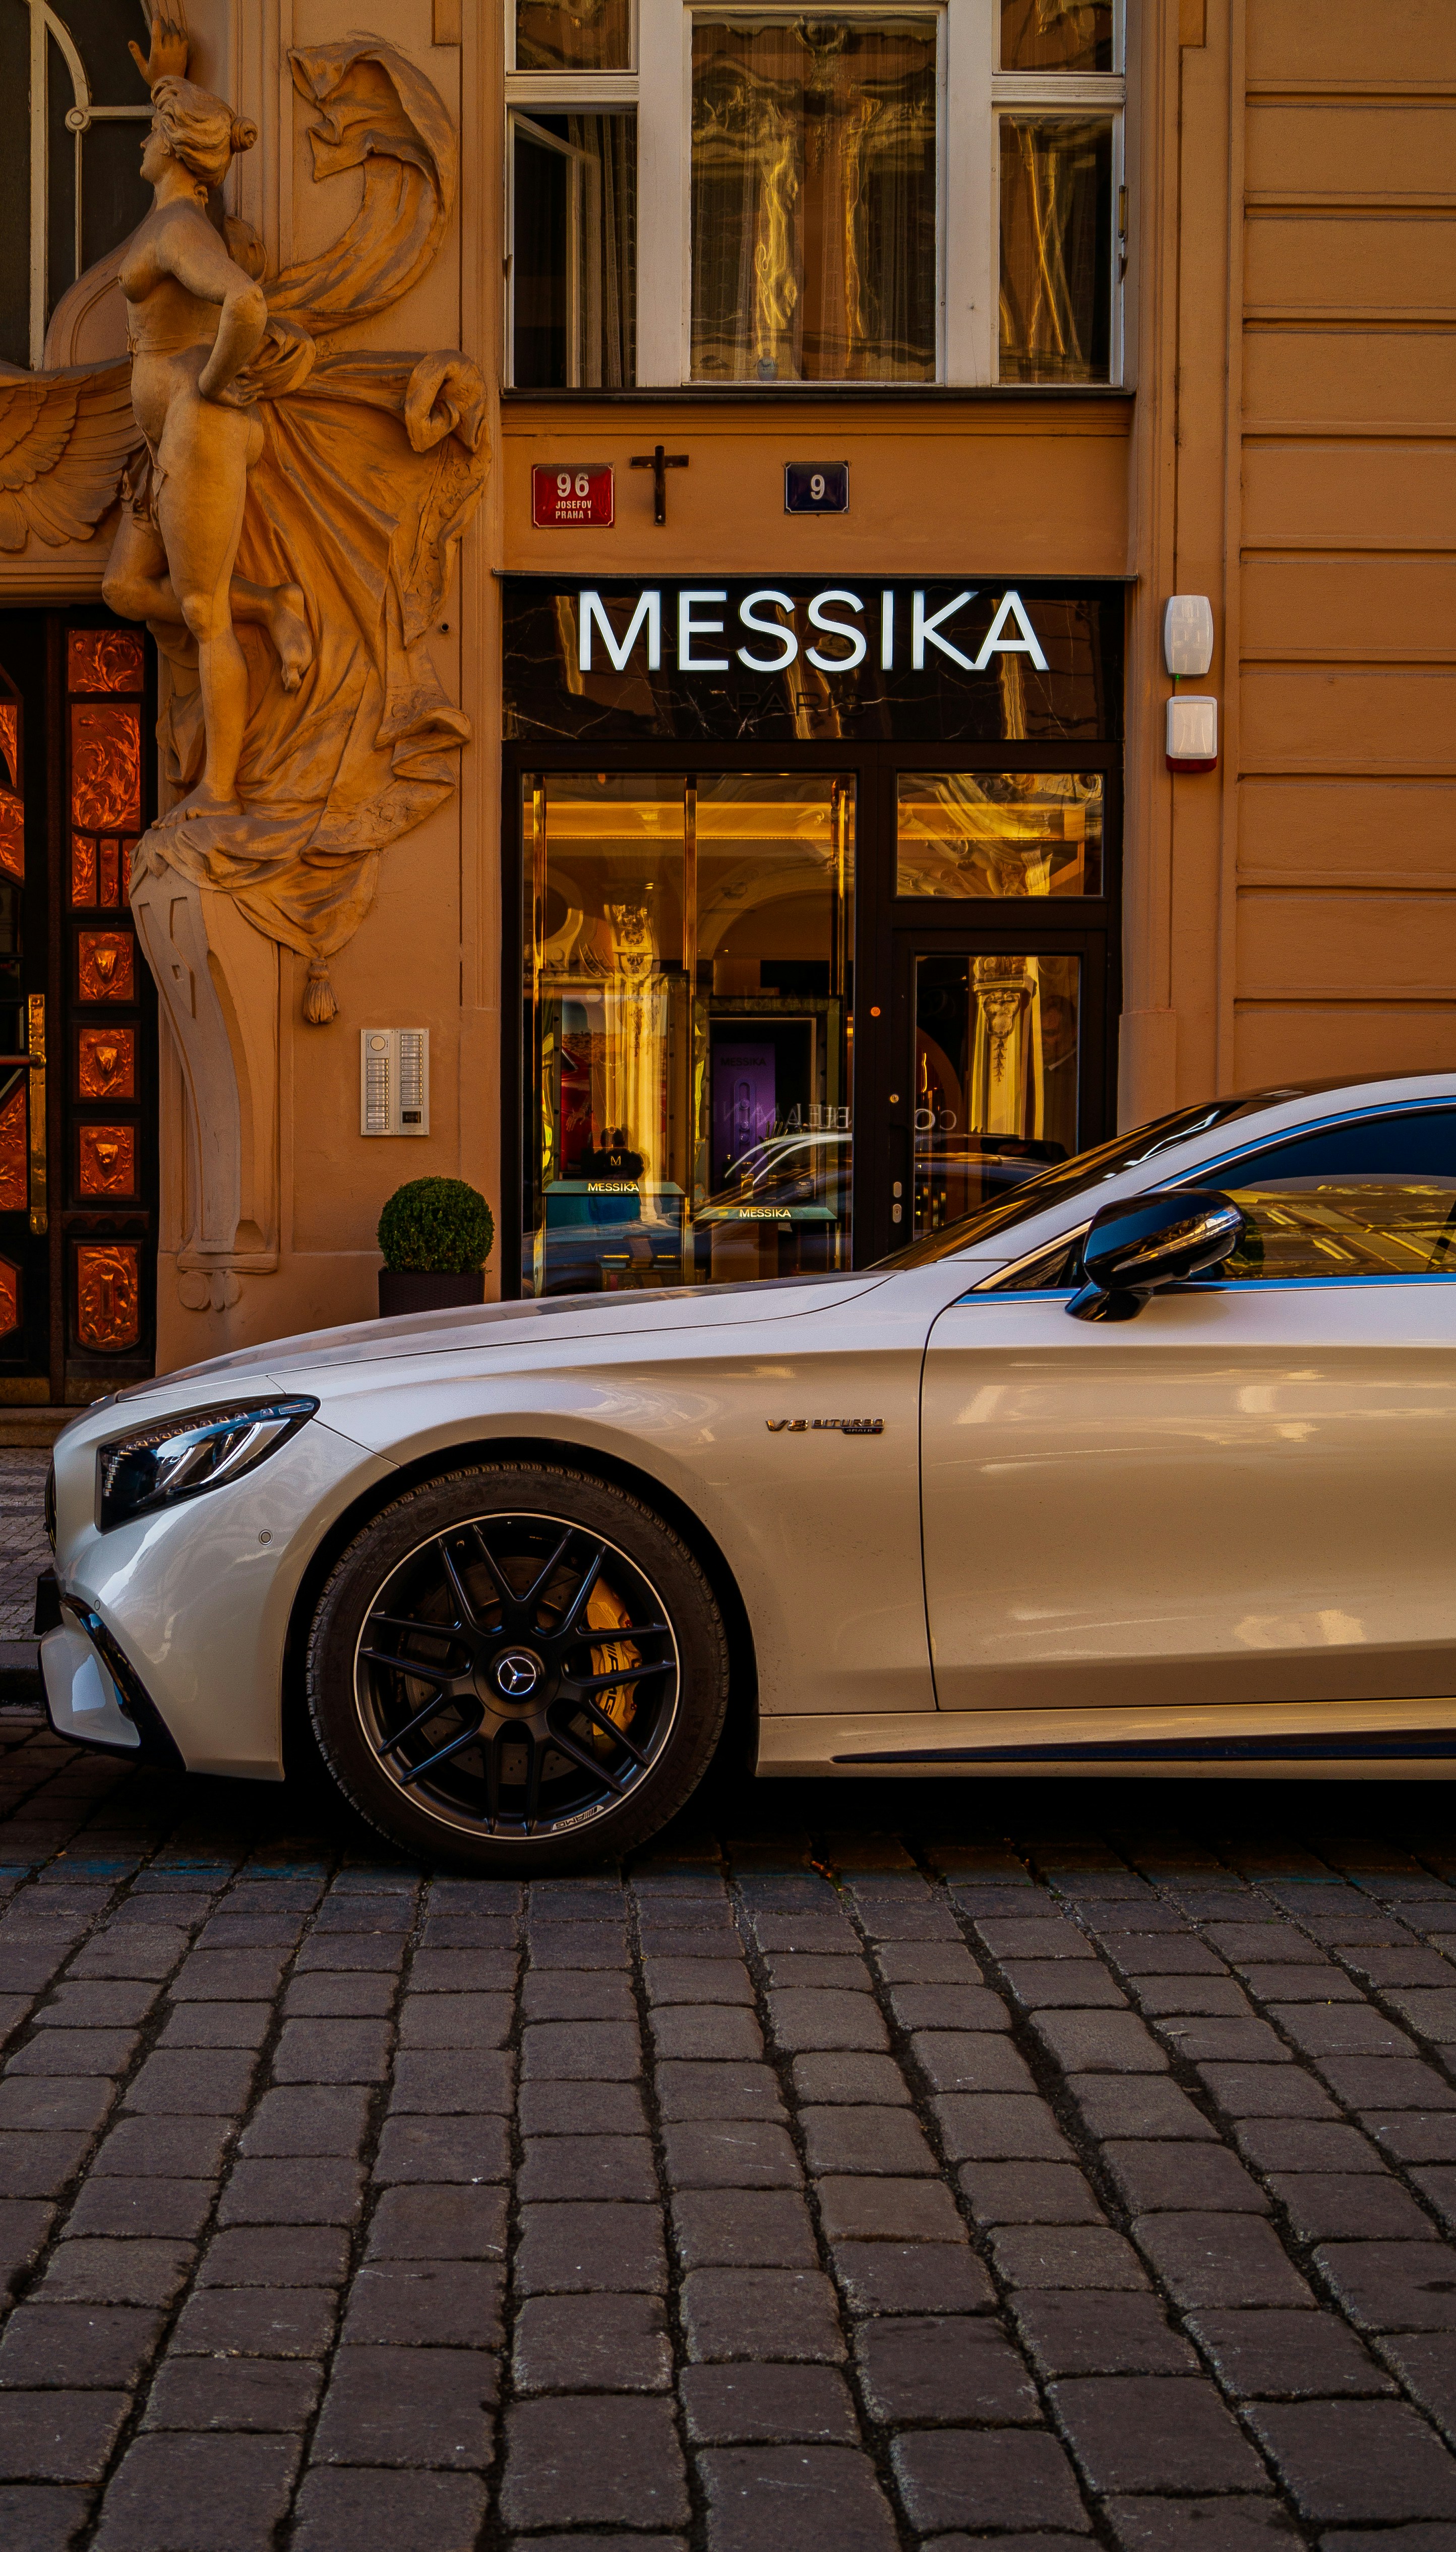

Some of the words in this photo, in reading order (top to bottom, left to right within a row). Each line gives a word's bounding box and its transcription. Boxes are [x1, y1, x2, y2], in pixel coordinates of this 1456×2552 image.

[557, 472, 589, 498] 96
[810, 474, 825, 500] 9
[556, 500, 592, 509] JOSEFOV
[556, 510, 583, 519] PRAHA
[587, 510, 591, 519] 1
[579, 590, 1049, 672] MESSIKA
[736, 691, 866, 717] PARIS
[720, 1057, 766, 1066] MESSIKA
[587, 1182, 639, 1192] MESSIKA
[739, 1208, 791, 1218] MESSIKA
[766, 1419, 809, 1431] V8
[812, 1418, 885, 1427] BITURBO
[555, 1814, 586, 1829] AMG
